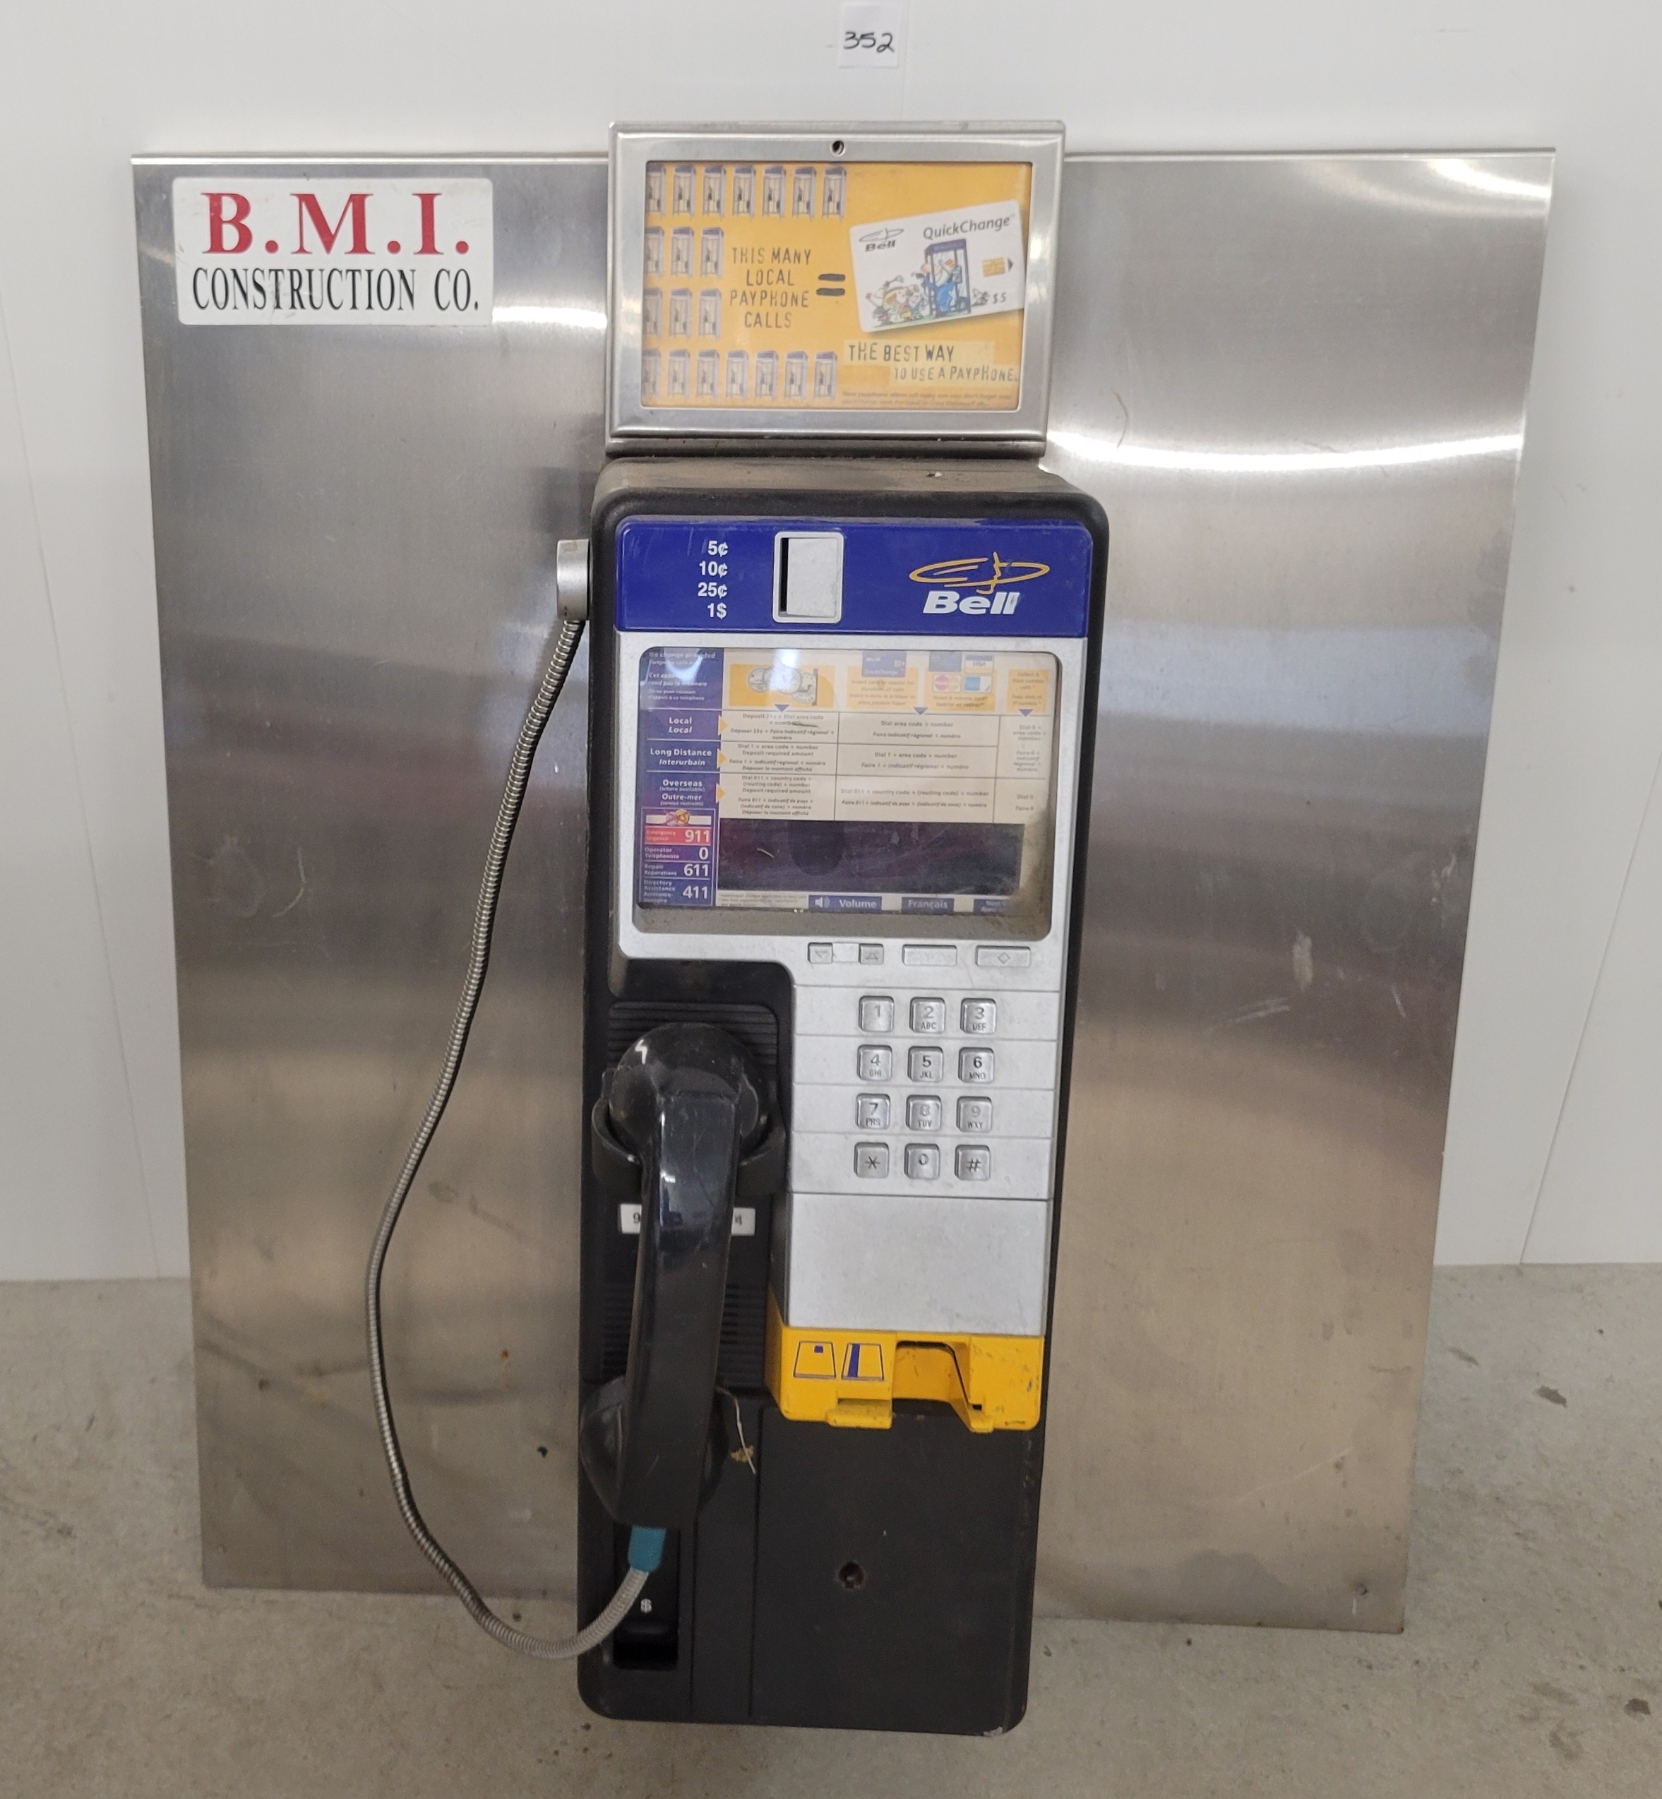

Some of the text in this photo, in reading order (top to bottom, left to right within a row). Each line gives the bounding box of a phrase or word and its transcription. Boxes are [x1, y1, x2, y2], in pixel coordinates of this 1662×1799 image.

[843, 31, 894, 53] 352
[201, 193, 469, 255] B.M.I.
[865, 240, 896, 252] Bell
[732, 247, 811, 265] THIS MANY
[746, 269, 795, 286] LOCAL
[193, 267, 480, 311] CONSTRUCTION CO.
[730, 290, 809, 307] PAYPHONE
[744, 311, 792, 329] CALLS
[848, 341, 955, 362] THE BEST WAY
[894, 367, 906, 380] TO
[911, 367, 934, 382] USE
[937, 367, 946, 380] A
[707, 541, 729, 557] 5¢
[699, 561, 728, 577] 10¢
[697, 583, 728, 598] 25¢
[922, 591, 1021, 616] Bell
[708, 603, 727, 619] 1$
[668, 717, 693, 725] Local
[668, 726, 693, 734] Local
[650, 748, 712, 758] Long Distance
[663, 779, 703, 787] Overseas
[662, 793, 703, 801] Outre-mer
[684, 829, 710, 843] 911
[698, 846, 709, 860] 0
[683, 863, 709, 877] 611
[682, 886, 708, 899] 411
[839, 898, 948, 911] Volume Français
[874, 1005, 881, 1018] 1
[924, 1006, 934, 1019] 2
[974, 1007, 985, 1019] 3
[920, 1022, 937, 1031] ABC
[972, 1023, 987, 1031] DEF
[870, 1054, 881, 1066] 4
[922, 1055, 931, 1068] 5
[973, 1056, 983, 1069] 6
[869, 1102, 879, 1115] 7
[919, 1104, 930, 1117] 8
[971, 1107, 981, 1118] 9
[917, 1120, 932, 1128] TUV
[967, 1121, 984, 1129] WXY
[918, 1153, 929, 1166] 0
[641, 1598, 653, 1613] $
